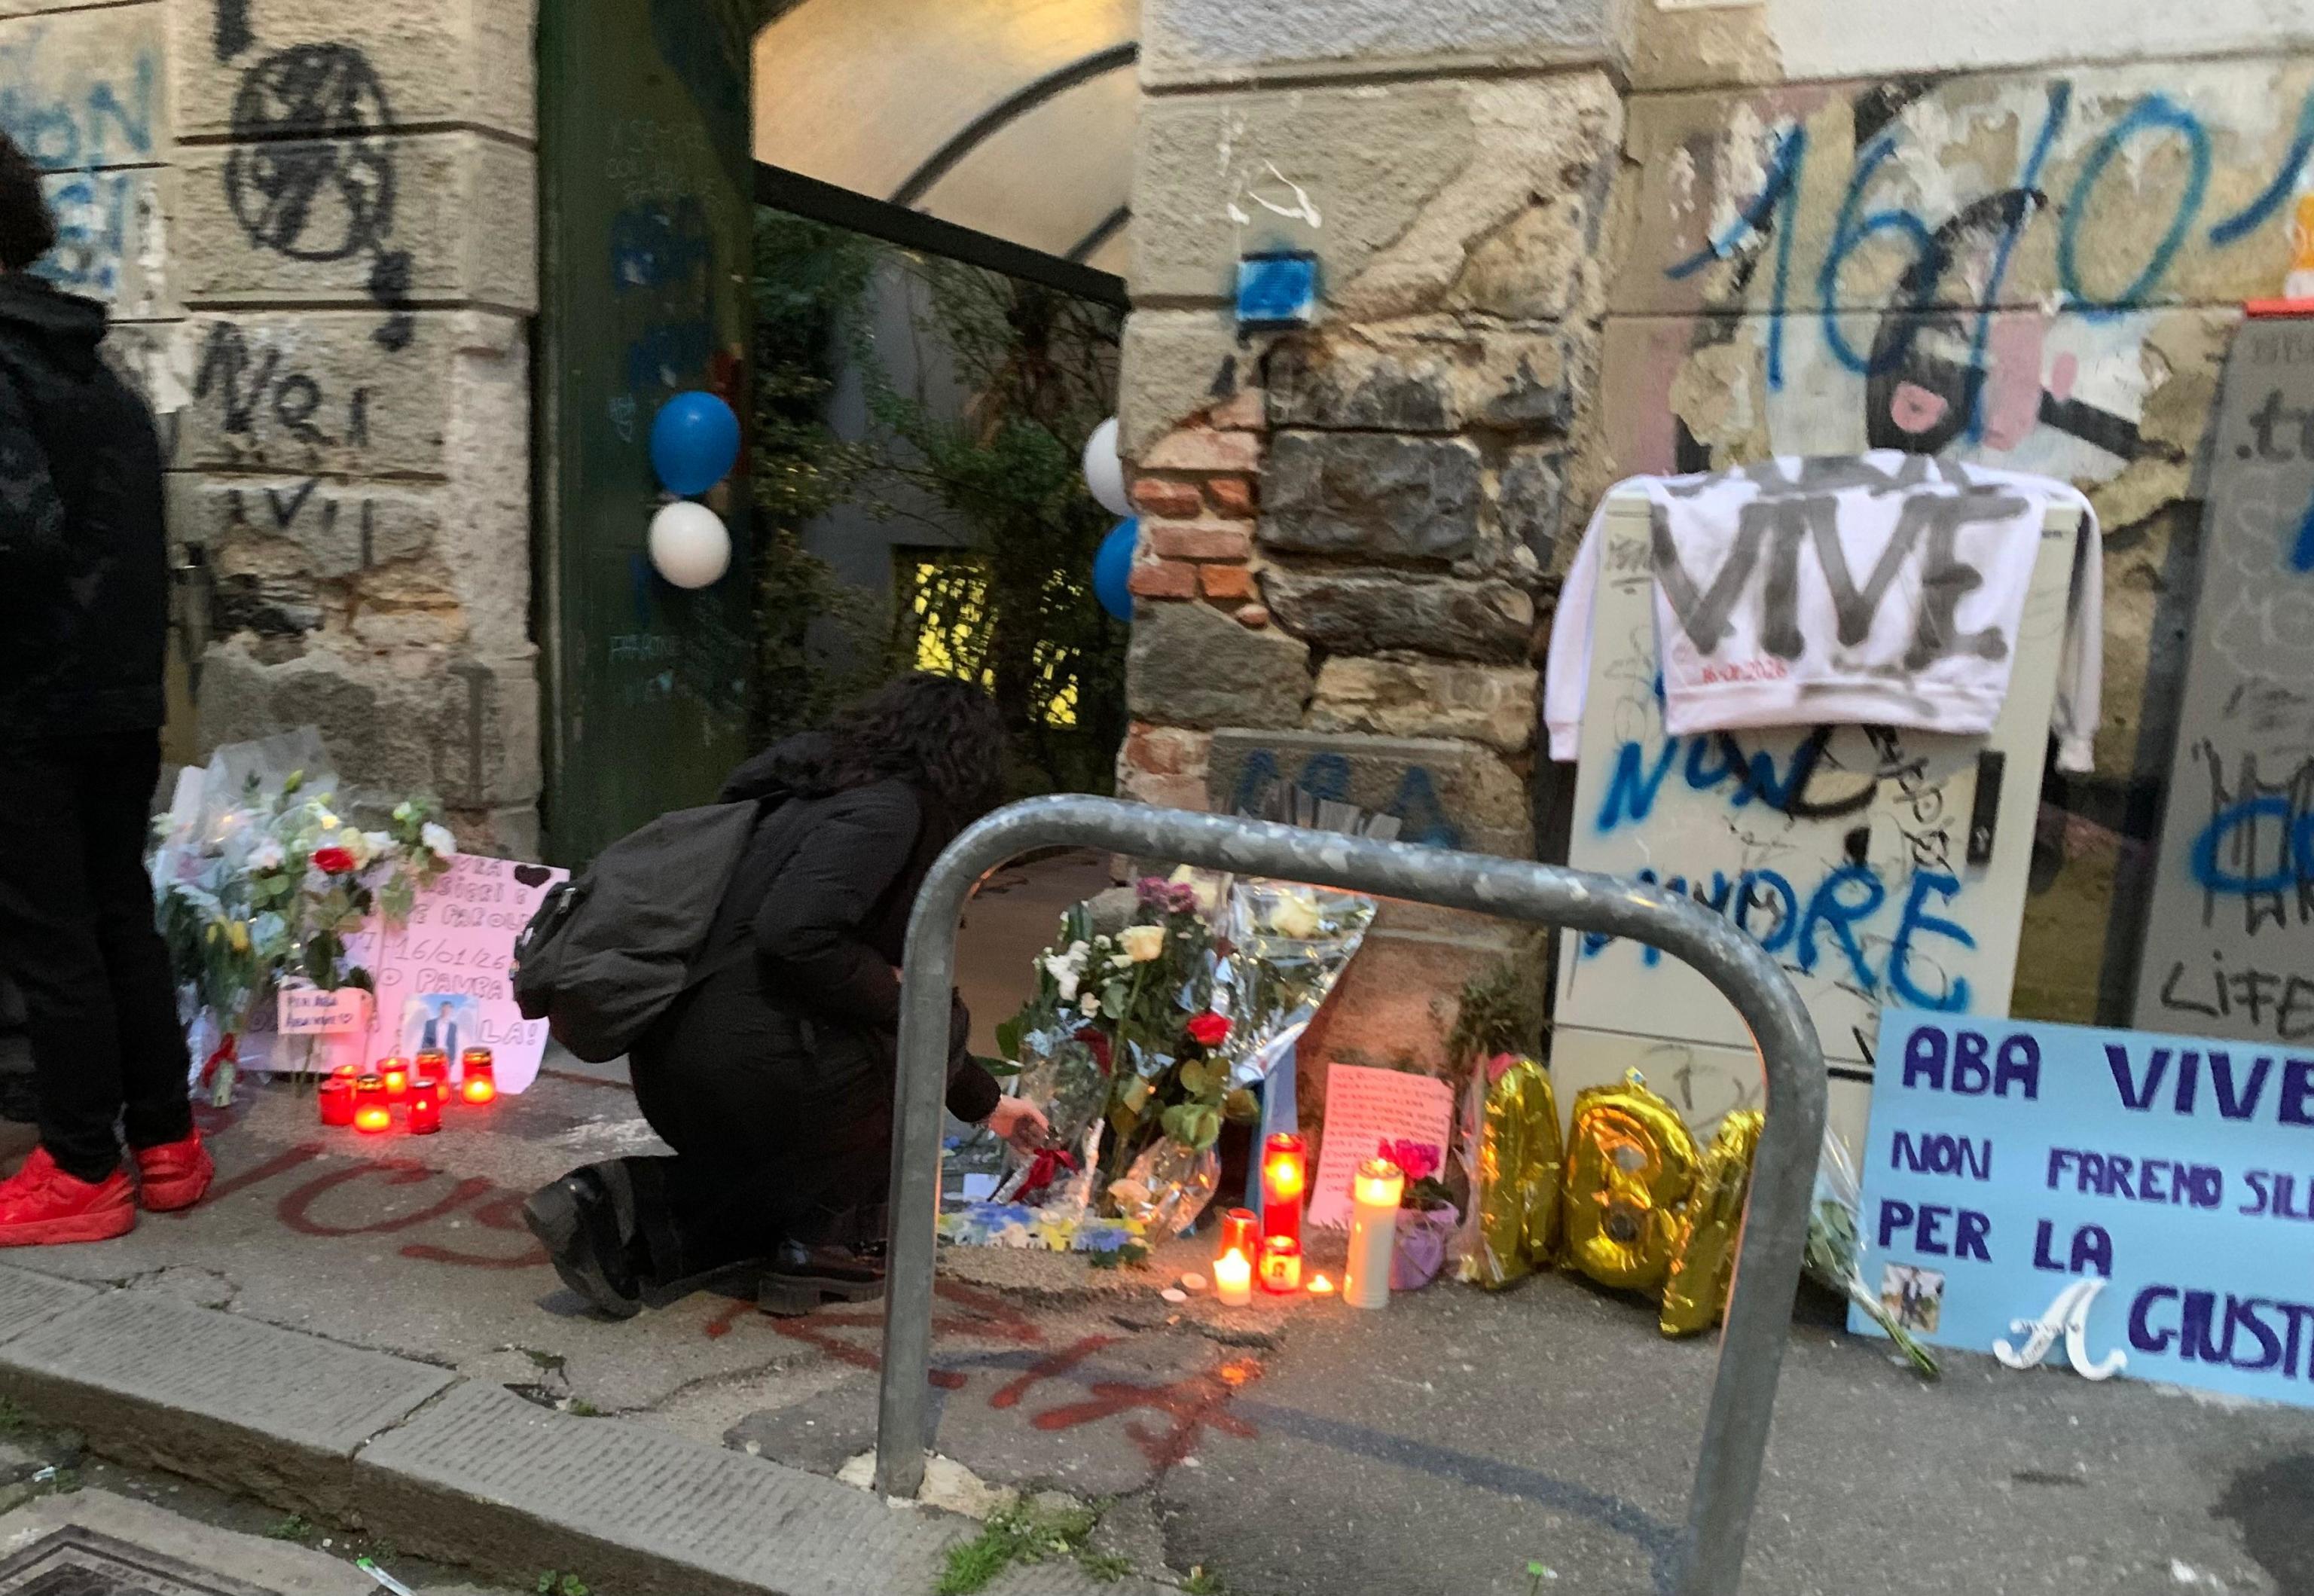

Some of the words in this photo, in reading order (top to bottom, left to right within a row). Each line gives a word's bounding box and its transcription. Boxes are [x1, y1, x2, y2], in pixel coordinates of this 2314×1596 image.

[1651, 494, 2029, 669] VIVE
[416, 968, 504, 1000] PAURA
[1582, 866, 1979, 1014] ORE
[1903, 1026, 2041, 1100] ABA
[2104, 1043, 2314, 1126] VIVE
[1891, 1131, 1992, 1181] NON
[2238, 1170, 2314, 1222] SIL
[1877, 1199, 1993, 1262] PER
[2034, 1217, 2113, 1279] LA
